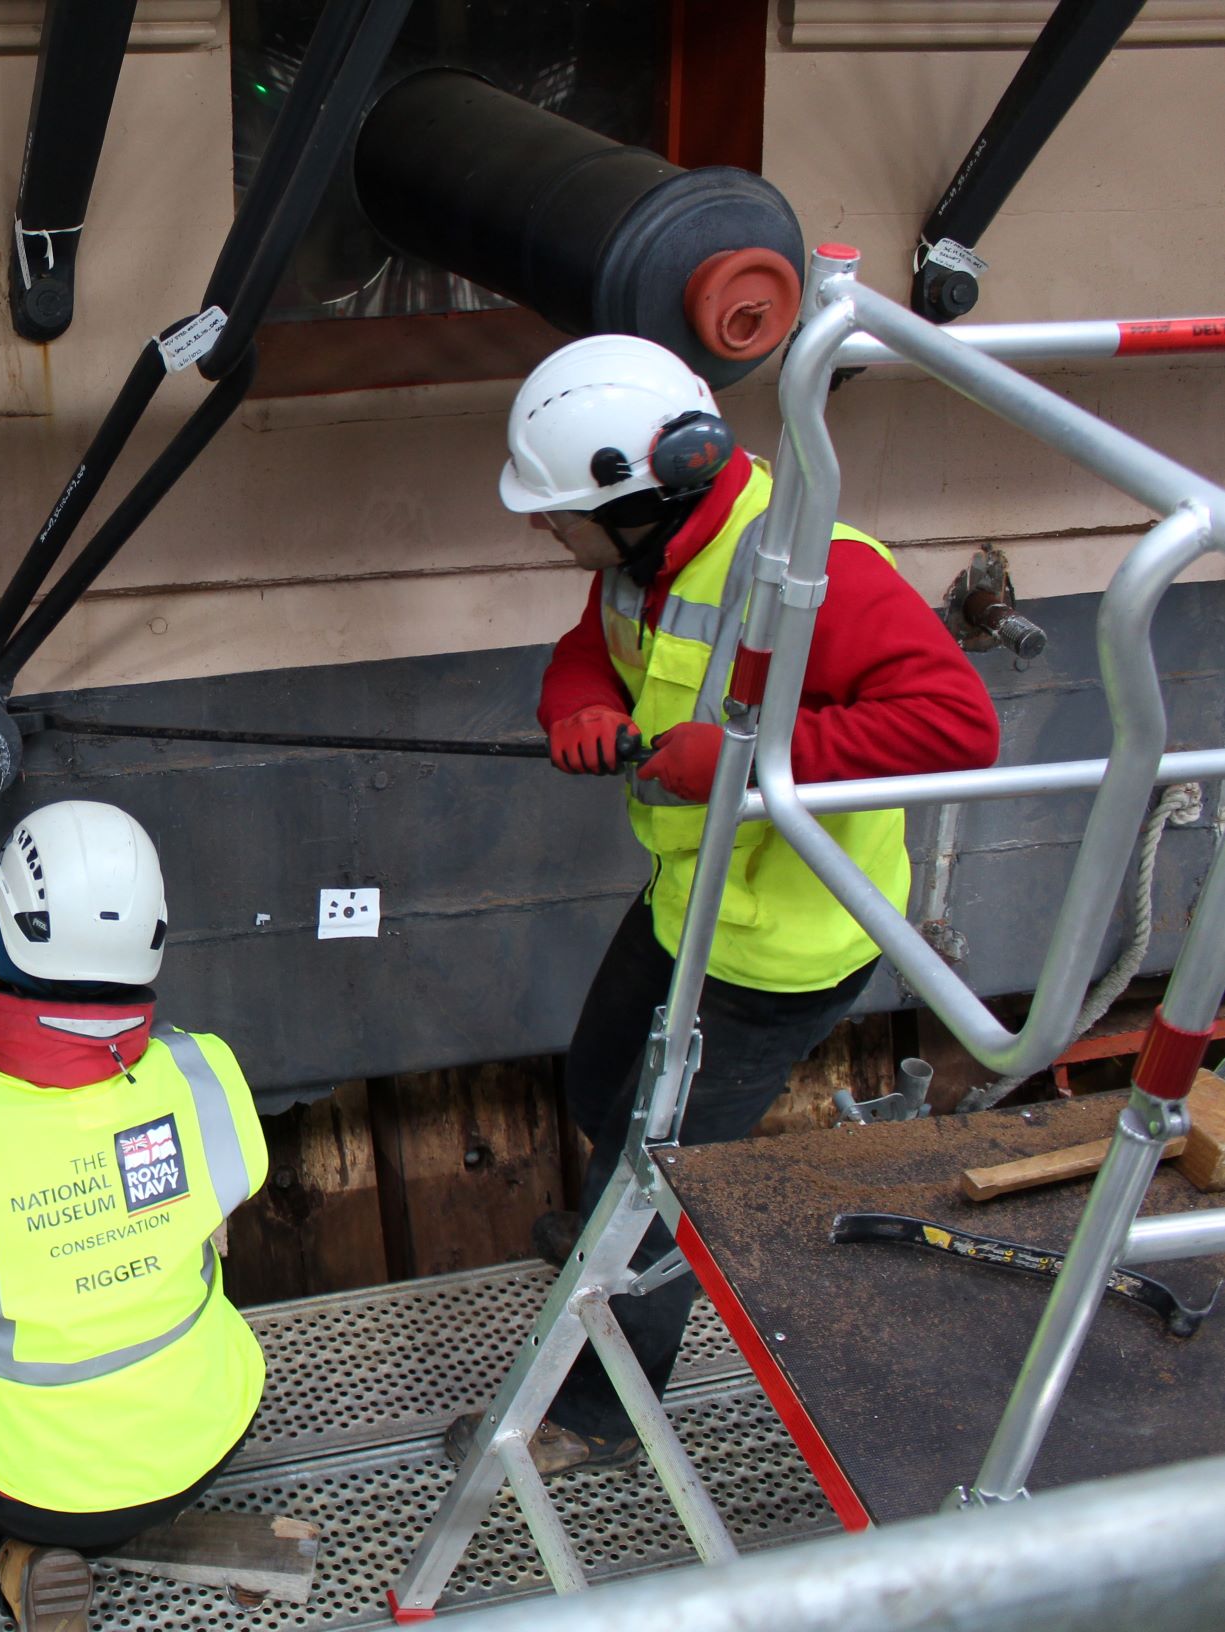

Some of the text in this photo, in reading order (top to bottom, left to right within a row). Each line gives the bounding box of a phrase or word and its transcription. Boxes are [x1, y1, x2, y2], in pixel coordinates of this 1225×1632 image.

[70, 1151, 107, 1175] THE
[127, 1159, 178, 1187] ROYAL
[10, 1174, 112, 1213] NATIONAL
[129, 1172, 179, 1203] NAVY
[26, 1194, 116, 1232] MUSEUM
[50, 1212, 170, 1258] CONSERVATION
[75, 1255, 162, 1294] RIGGER
